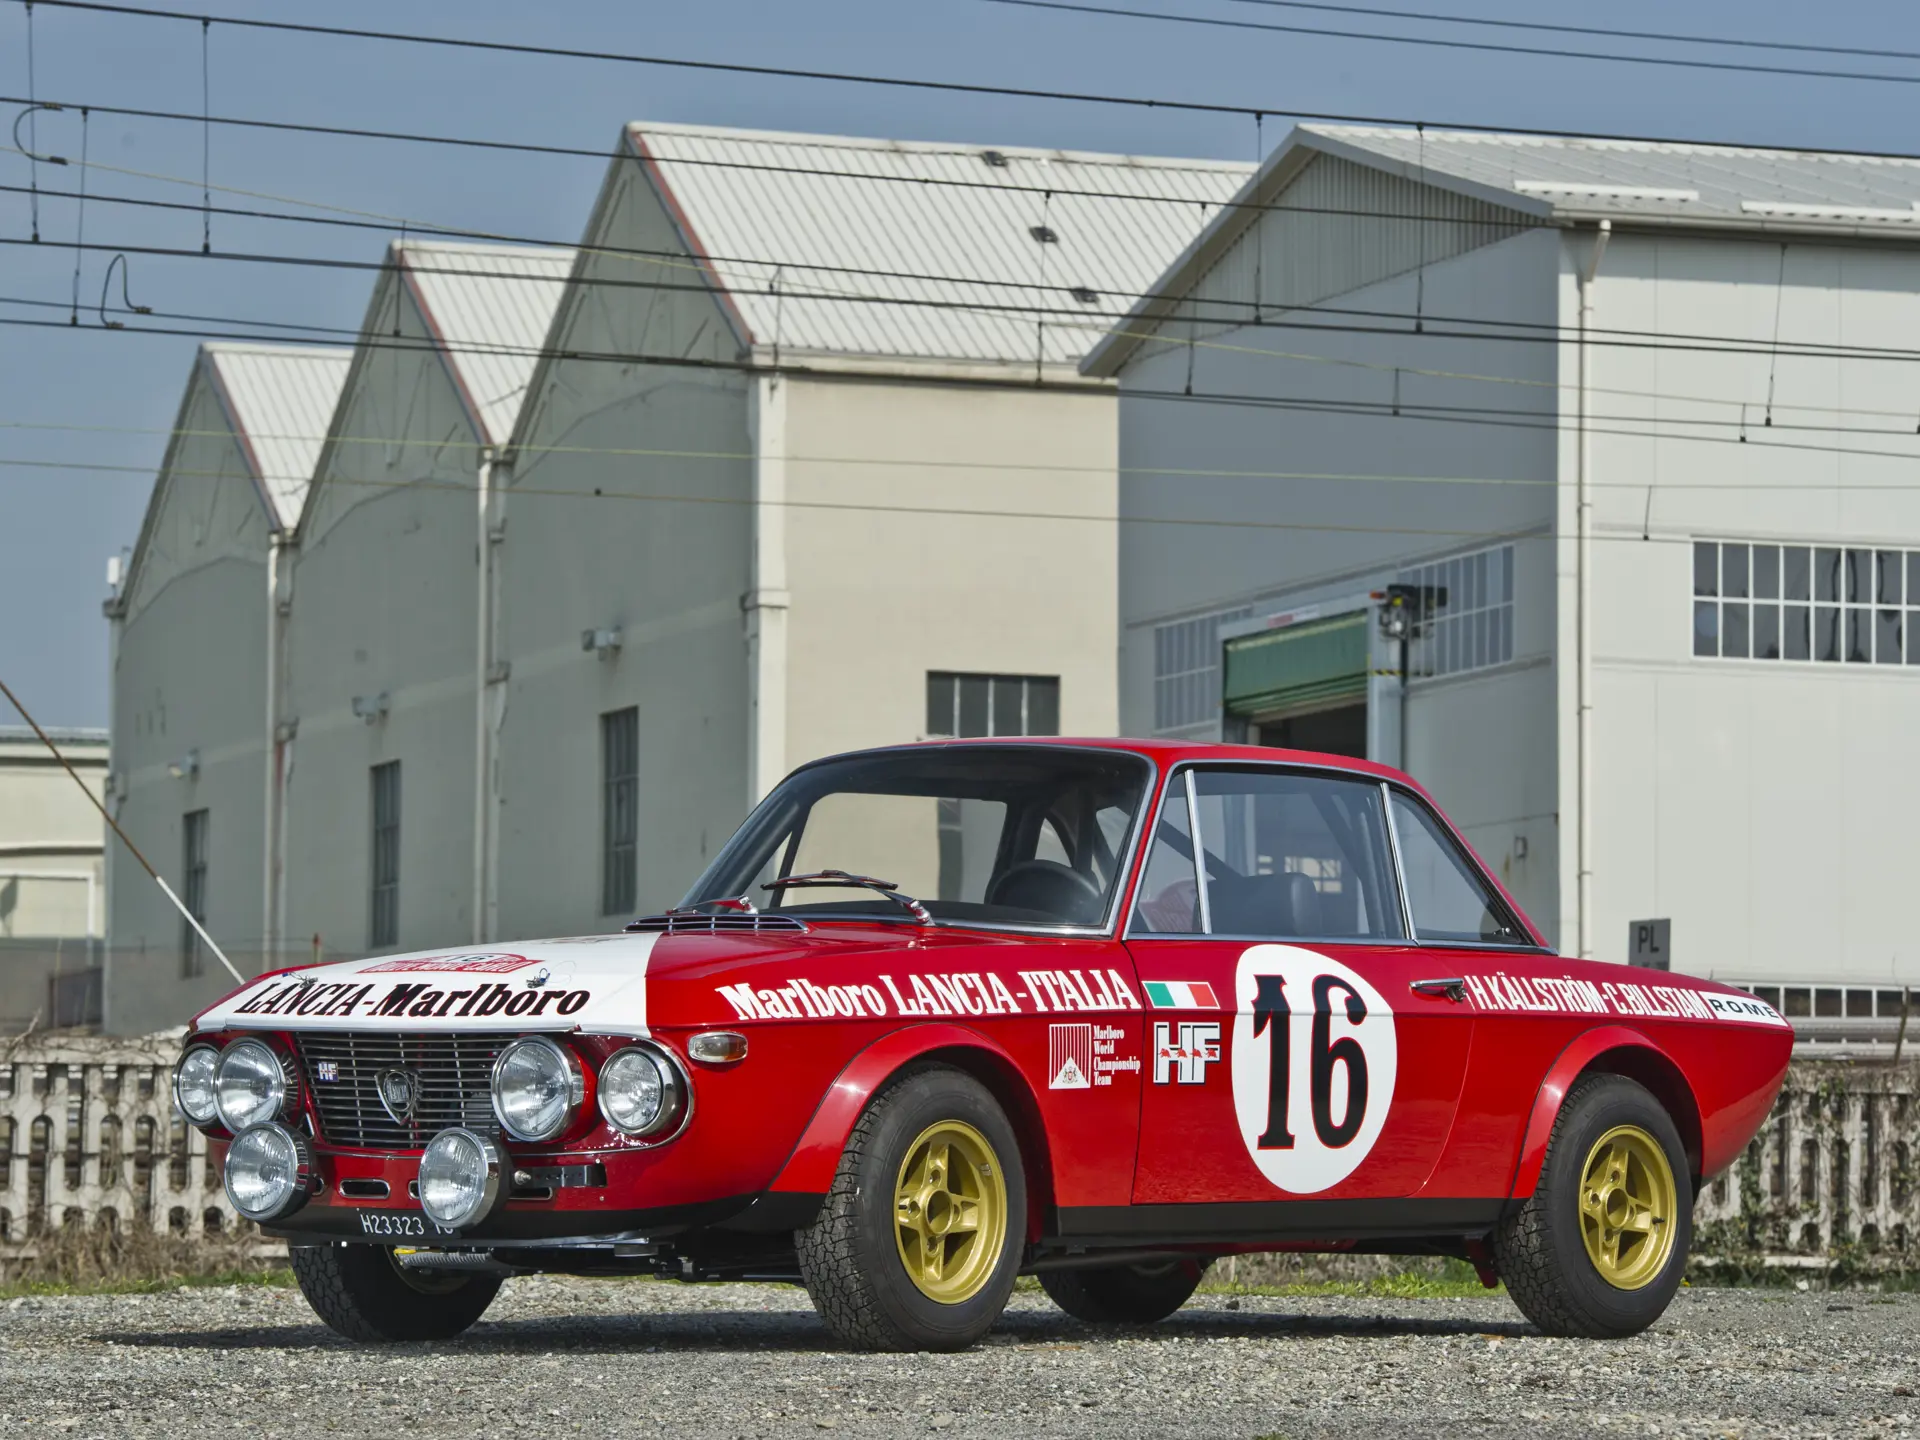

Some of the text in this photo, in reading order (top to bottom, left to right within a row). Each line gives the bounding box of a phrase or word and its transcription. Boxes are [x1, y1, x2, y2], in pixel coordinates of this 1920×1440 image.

[1638, 924, 1660, 954] PL
[233, 983, 591, 1018] LANCIA-Marlboro
[715, 969, 1143, 1021] Marlboro LANCIA-ITALIA
[1707, 998, 1780, 1019] ROME
[1093, 1025, 1125, 1040] Marlboro
[1093, 1040, 1115, 1055] World
[1153, 1021, 1221, 1086] HF
[318, 1062, 338, 1080] HF
[1093, 1056, 1141, 1075] Championship
[1250, 974, 1368, 1150] 16
[1093, 1071, 1112, 1086] Team
[360, 1213, 425, 1236] H23323
